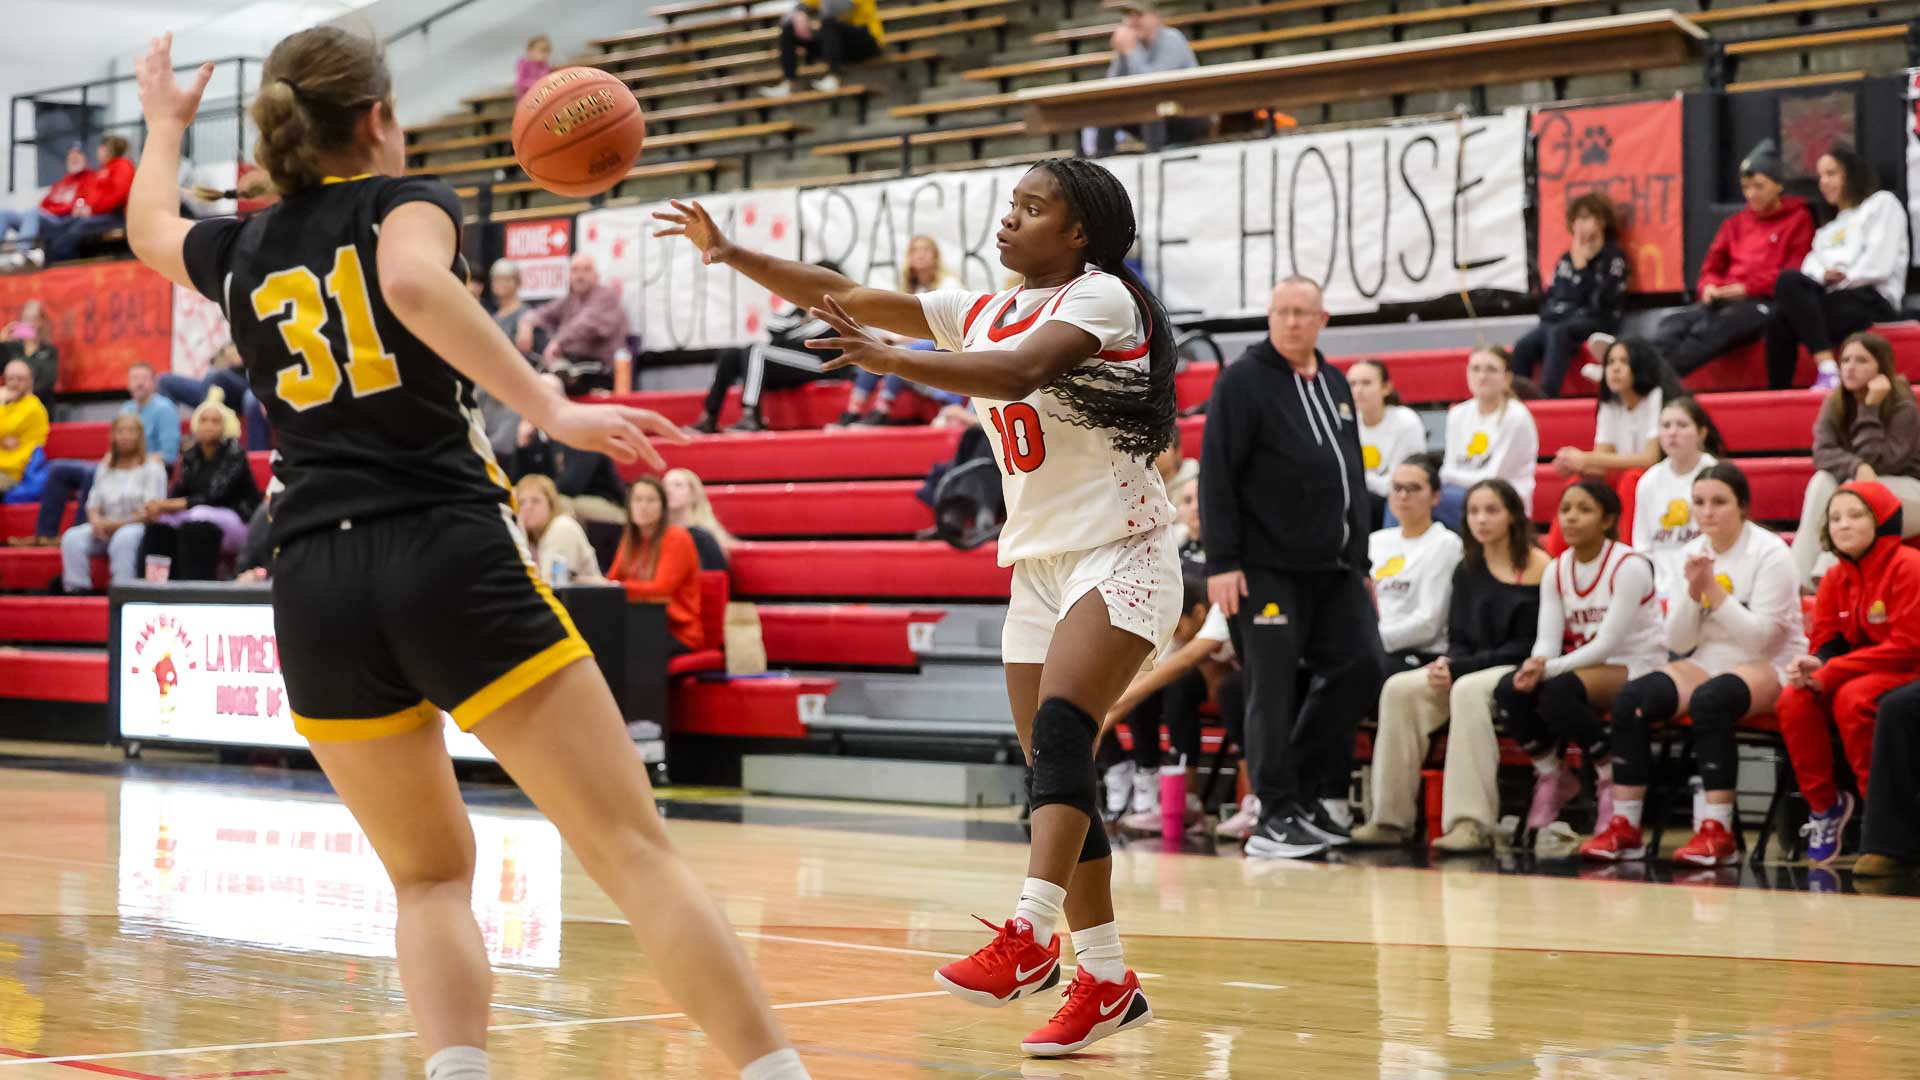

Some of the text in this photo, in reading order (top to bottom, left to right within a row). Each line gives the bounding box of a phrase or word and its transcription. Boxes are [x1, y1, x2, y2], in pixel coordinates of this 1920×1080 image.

[1239, 127, 1507, 308] HOUSE
[250, 244, 402, 412] 31
[988, 402, 1045, 475] 10
